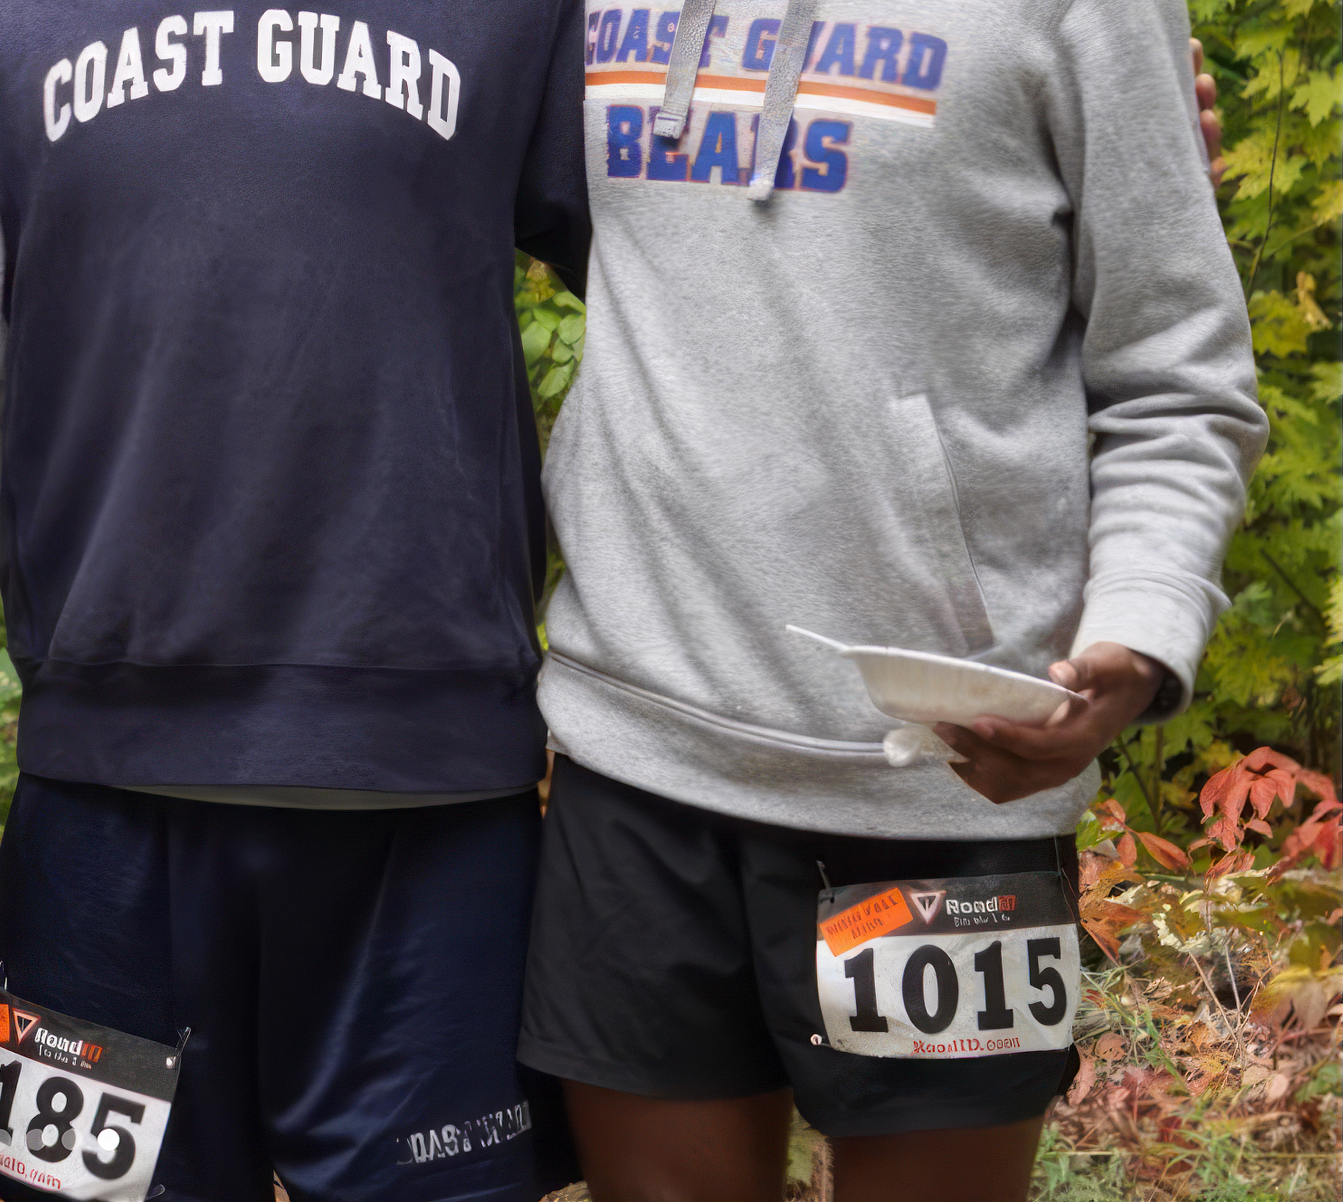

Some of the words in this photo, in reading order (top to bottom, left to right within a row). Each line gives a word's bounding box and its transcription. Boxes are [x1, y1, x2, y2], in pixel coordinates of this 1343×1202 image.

[43, 10, 235, 142] COAST
[257, 9, 461, 140] GUARD
[741, 17, 949, 91] GARD
[844, 937, 1067, 1034] 1015
